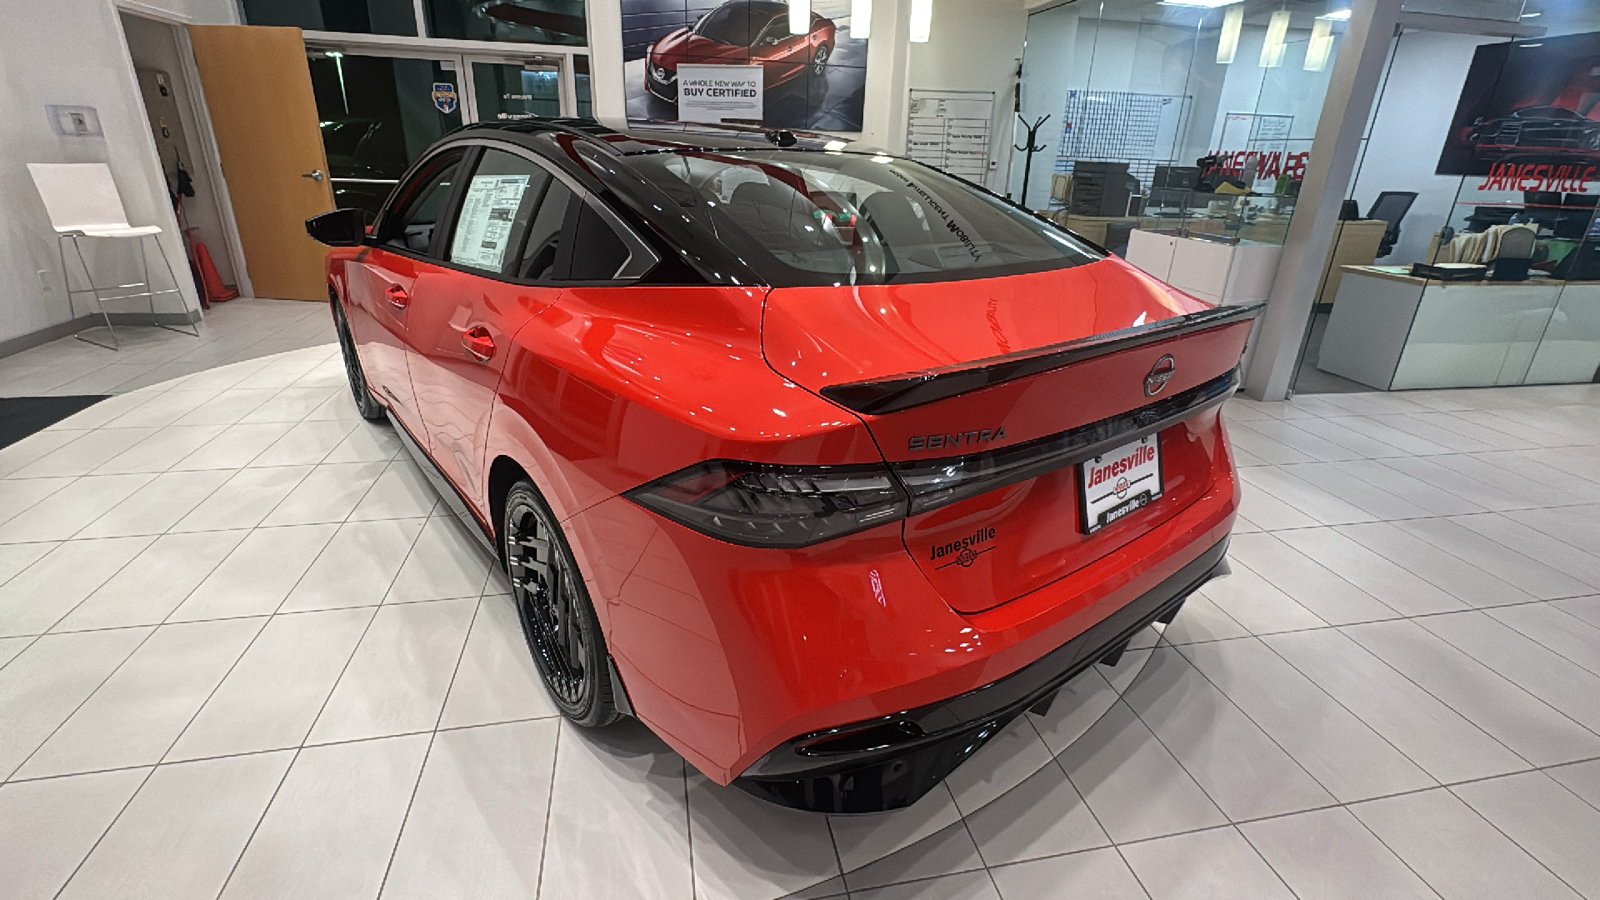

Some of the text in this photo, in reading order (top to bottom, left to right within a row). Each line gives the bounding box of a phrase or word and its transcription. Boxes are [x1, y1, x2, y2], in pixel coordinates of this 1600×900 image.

[684, 88, 758, 99] BUY CERTIFIED
[690, 80, 714, 88] WHOLE
[1478, 163, 1598, 193] JANESVILLE
[908, 426, 1008, 451] SENTRA
[1087, 445, 1155, 489] Janesville
[1106, 499, 1141, 524] Janesville
[930, 526, 996, 561] Janesville
